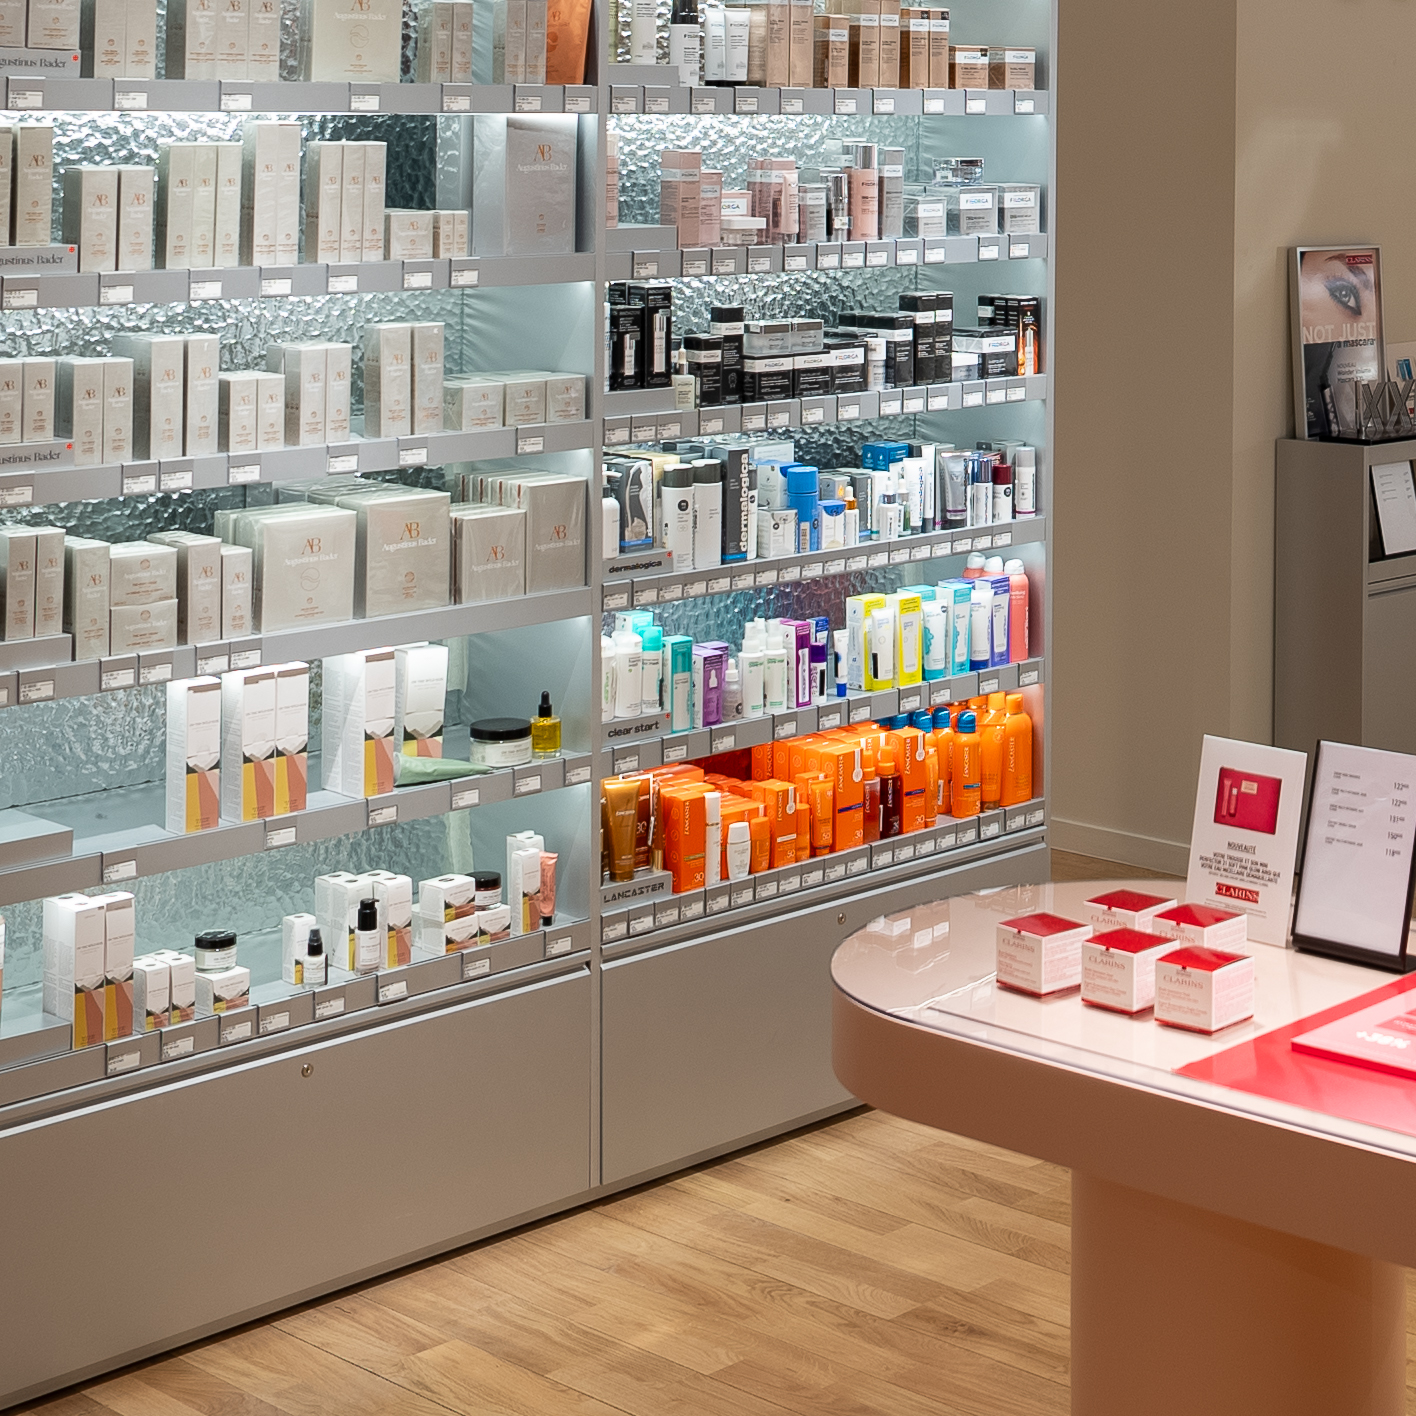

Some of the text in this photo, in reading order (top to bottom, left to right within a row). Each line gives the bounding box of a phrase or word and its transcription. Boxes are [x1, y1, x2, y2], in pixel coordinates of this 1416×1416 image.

[39, 57, 67, 70] Bader
[36, 253, 64, 265] Bader
[1303, 322, 1376, 344] NOT JUST
[34, 450, 61, 463] Bader
[739, 453, 750, 552] dermalogica
[609, 559, 663, 574] dermalogica
[608, 720, 660, 738] clear start
[604, 882, 665, 903] LANCASTER
[1216, 884, 1258, 902] CLARINS
[1163, 974, 1204, 989] CLARINS
